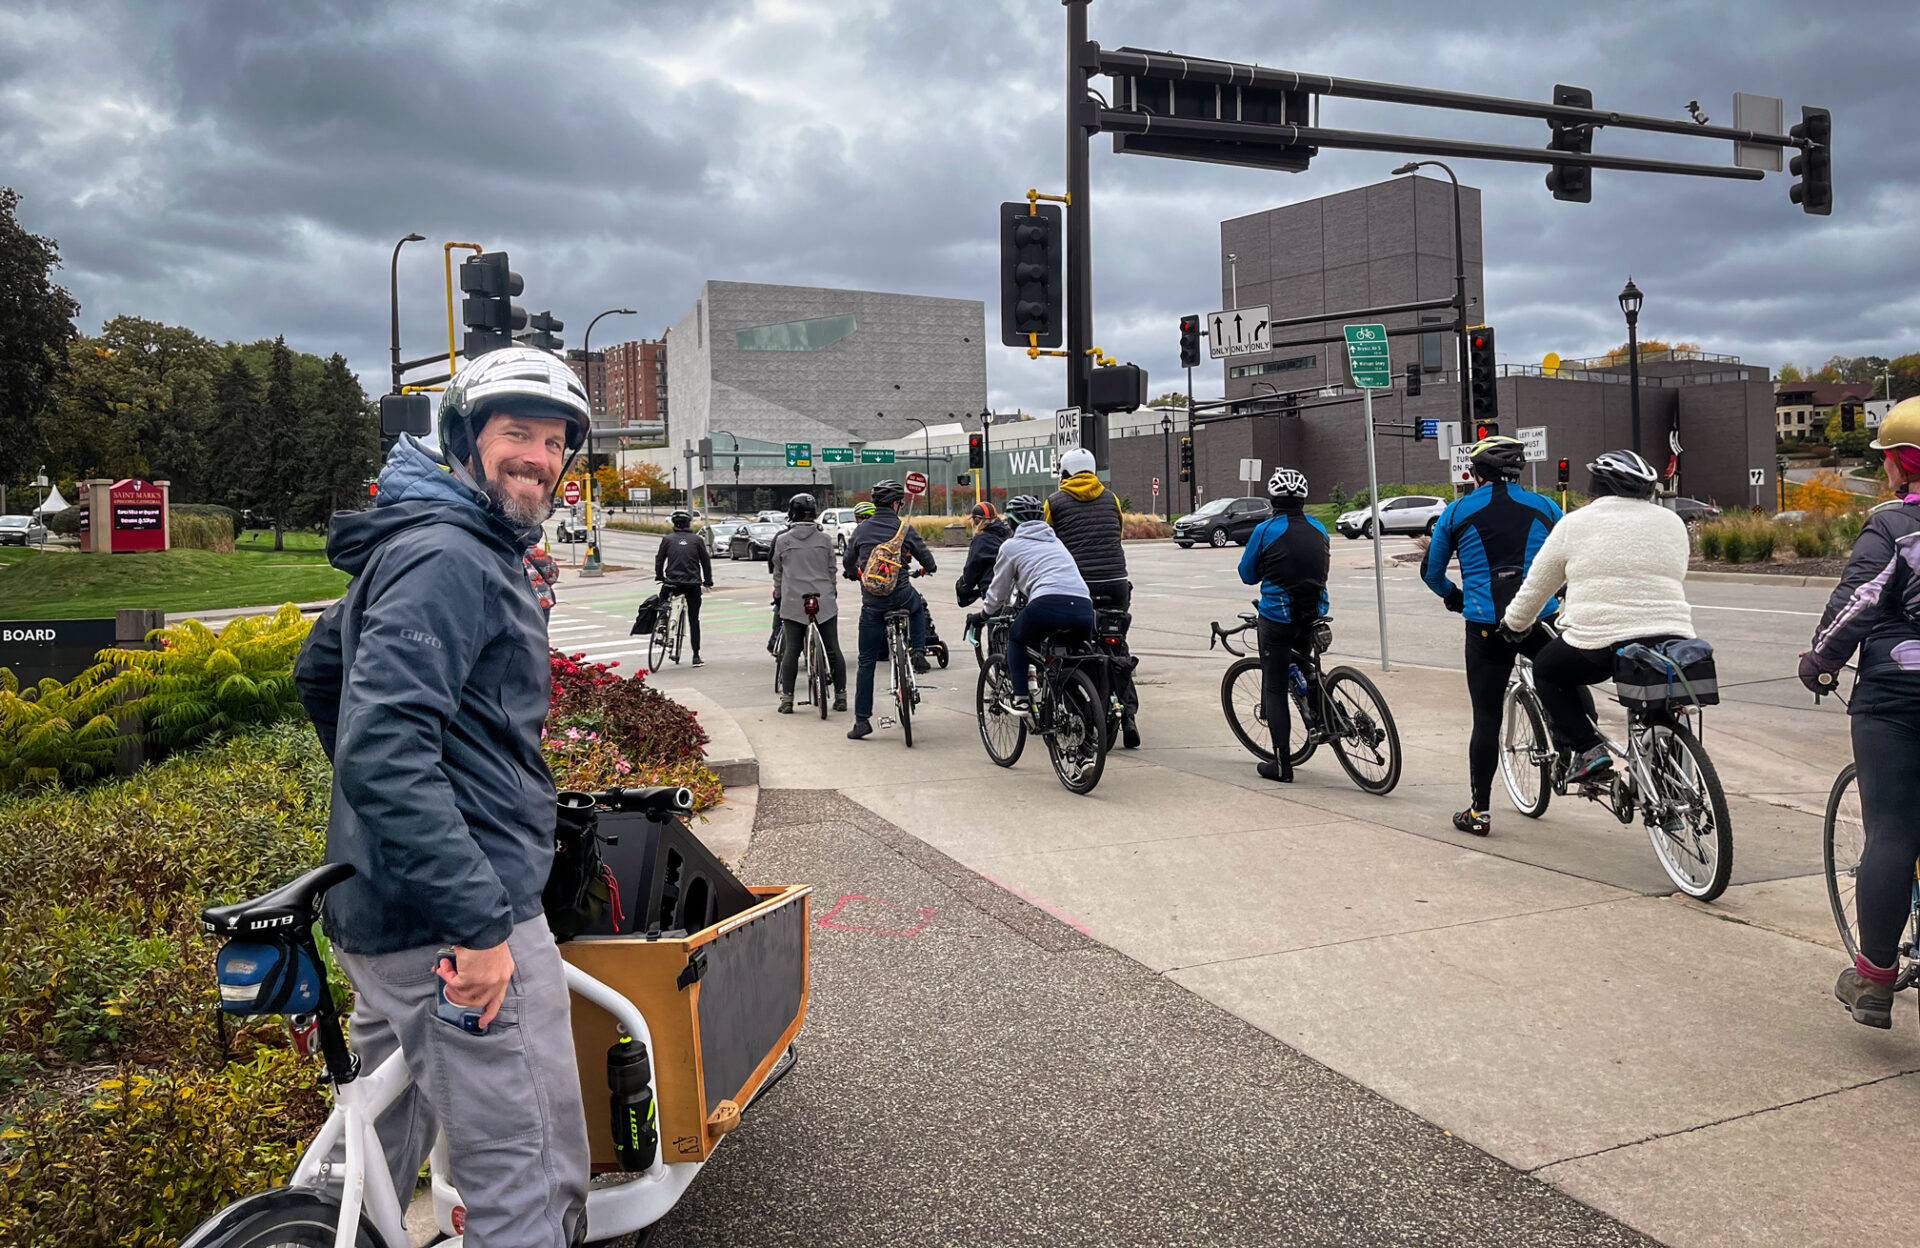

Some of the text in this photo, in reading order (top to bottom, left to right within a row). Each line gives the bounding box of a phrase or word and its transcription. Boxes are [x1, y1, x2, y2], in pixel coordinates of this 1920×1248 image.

[1211, 347, 1229, 355] ONLY
[1231, 344, 1249, 353] ONLY
[1251, 341, 1269, 350] ONLY
[1060, 413, 1077, 429] ONE
[1458, 446, 1471, 454] NO
[1008, 448, 1055, 475] WAL
[3, 629, 56, 641] BOARD
[400, 629, 442, 649] GIRO
[251, 915, 294, 930] WTB
[629, 1107, 639, 1150] SCOTT
